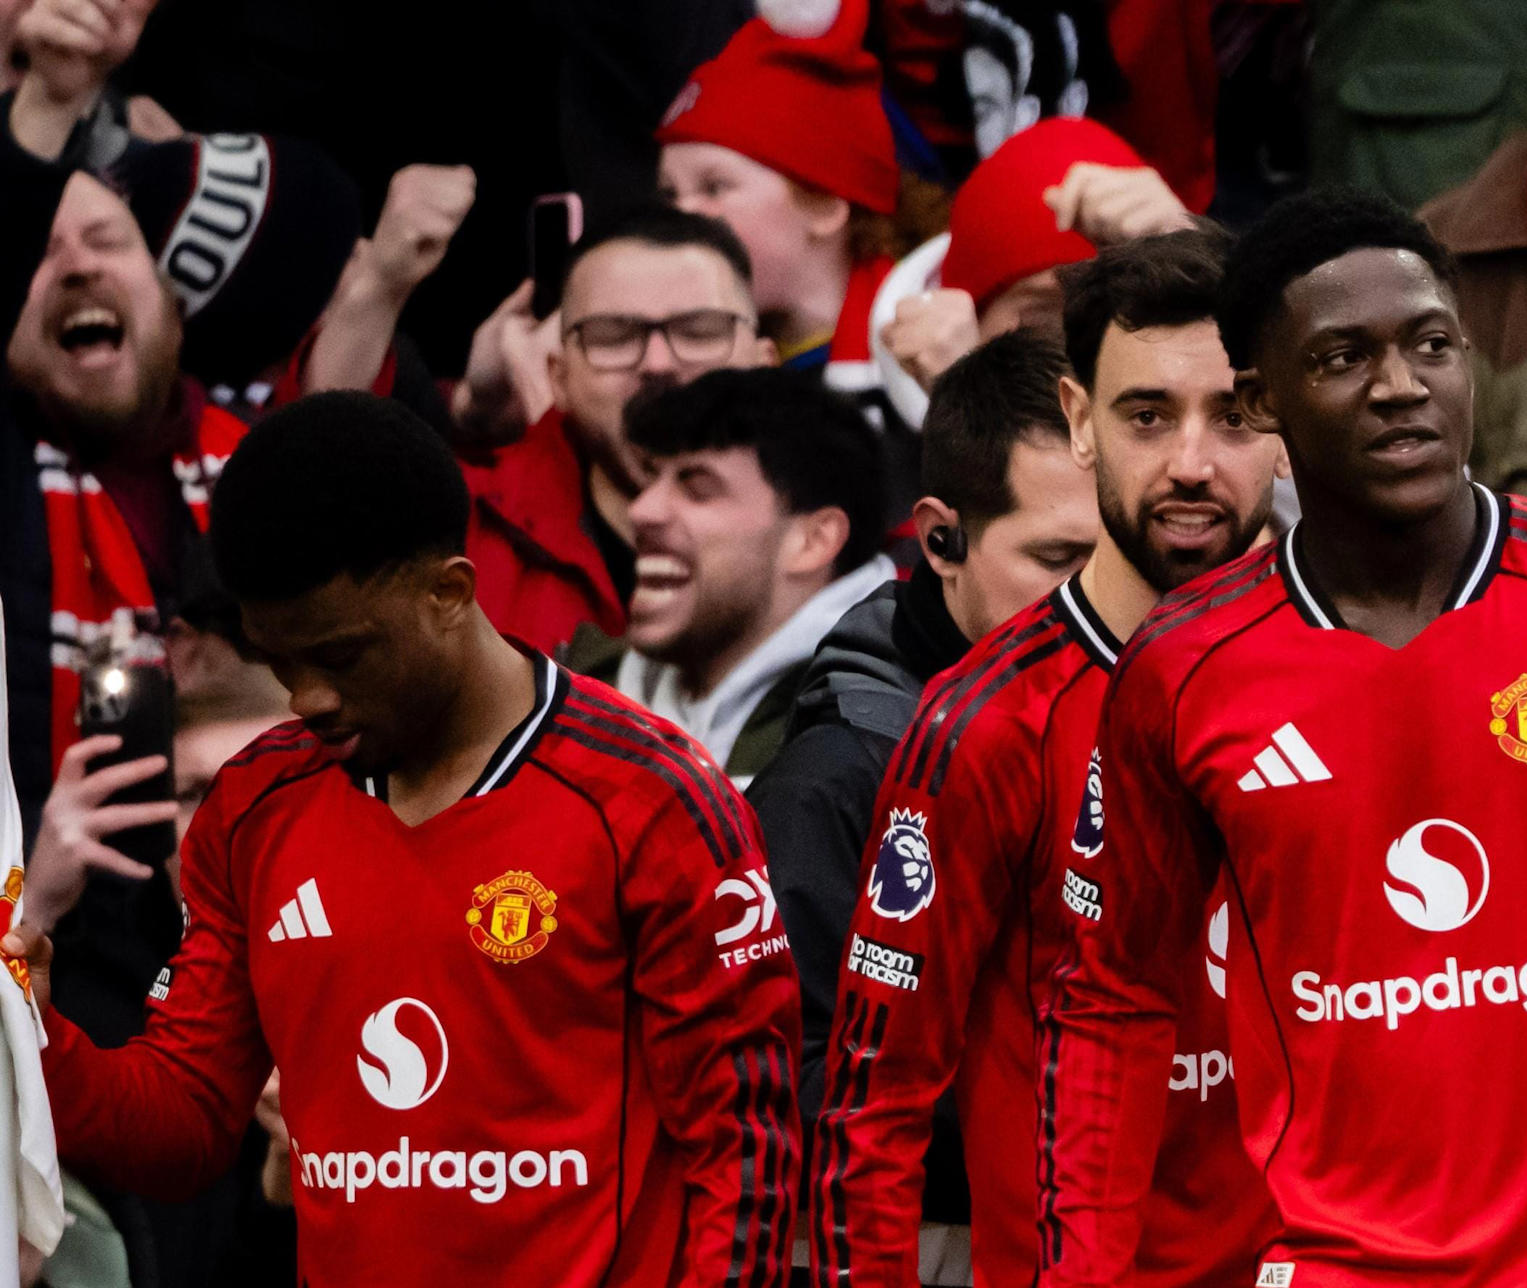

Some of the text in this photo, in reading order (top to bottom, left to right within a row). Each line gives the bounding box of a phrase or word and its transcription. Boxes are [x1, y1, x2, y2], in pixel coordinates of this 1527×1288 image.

[168, 133, 264, 292] OUL
[478, 877, 550, 911] MANCHESTER
[482, 939, 534, 957] UNITED
[865, 943, 914, 973] room
[861, 959, 919, 991] racism
